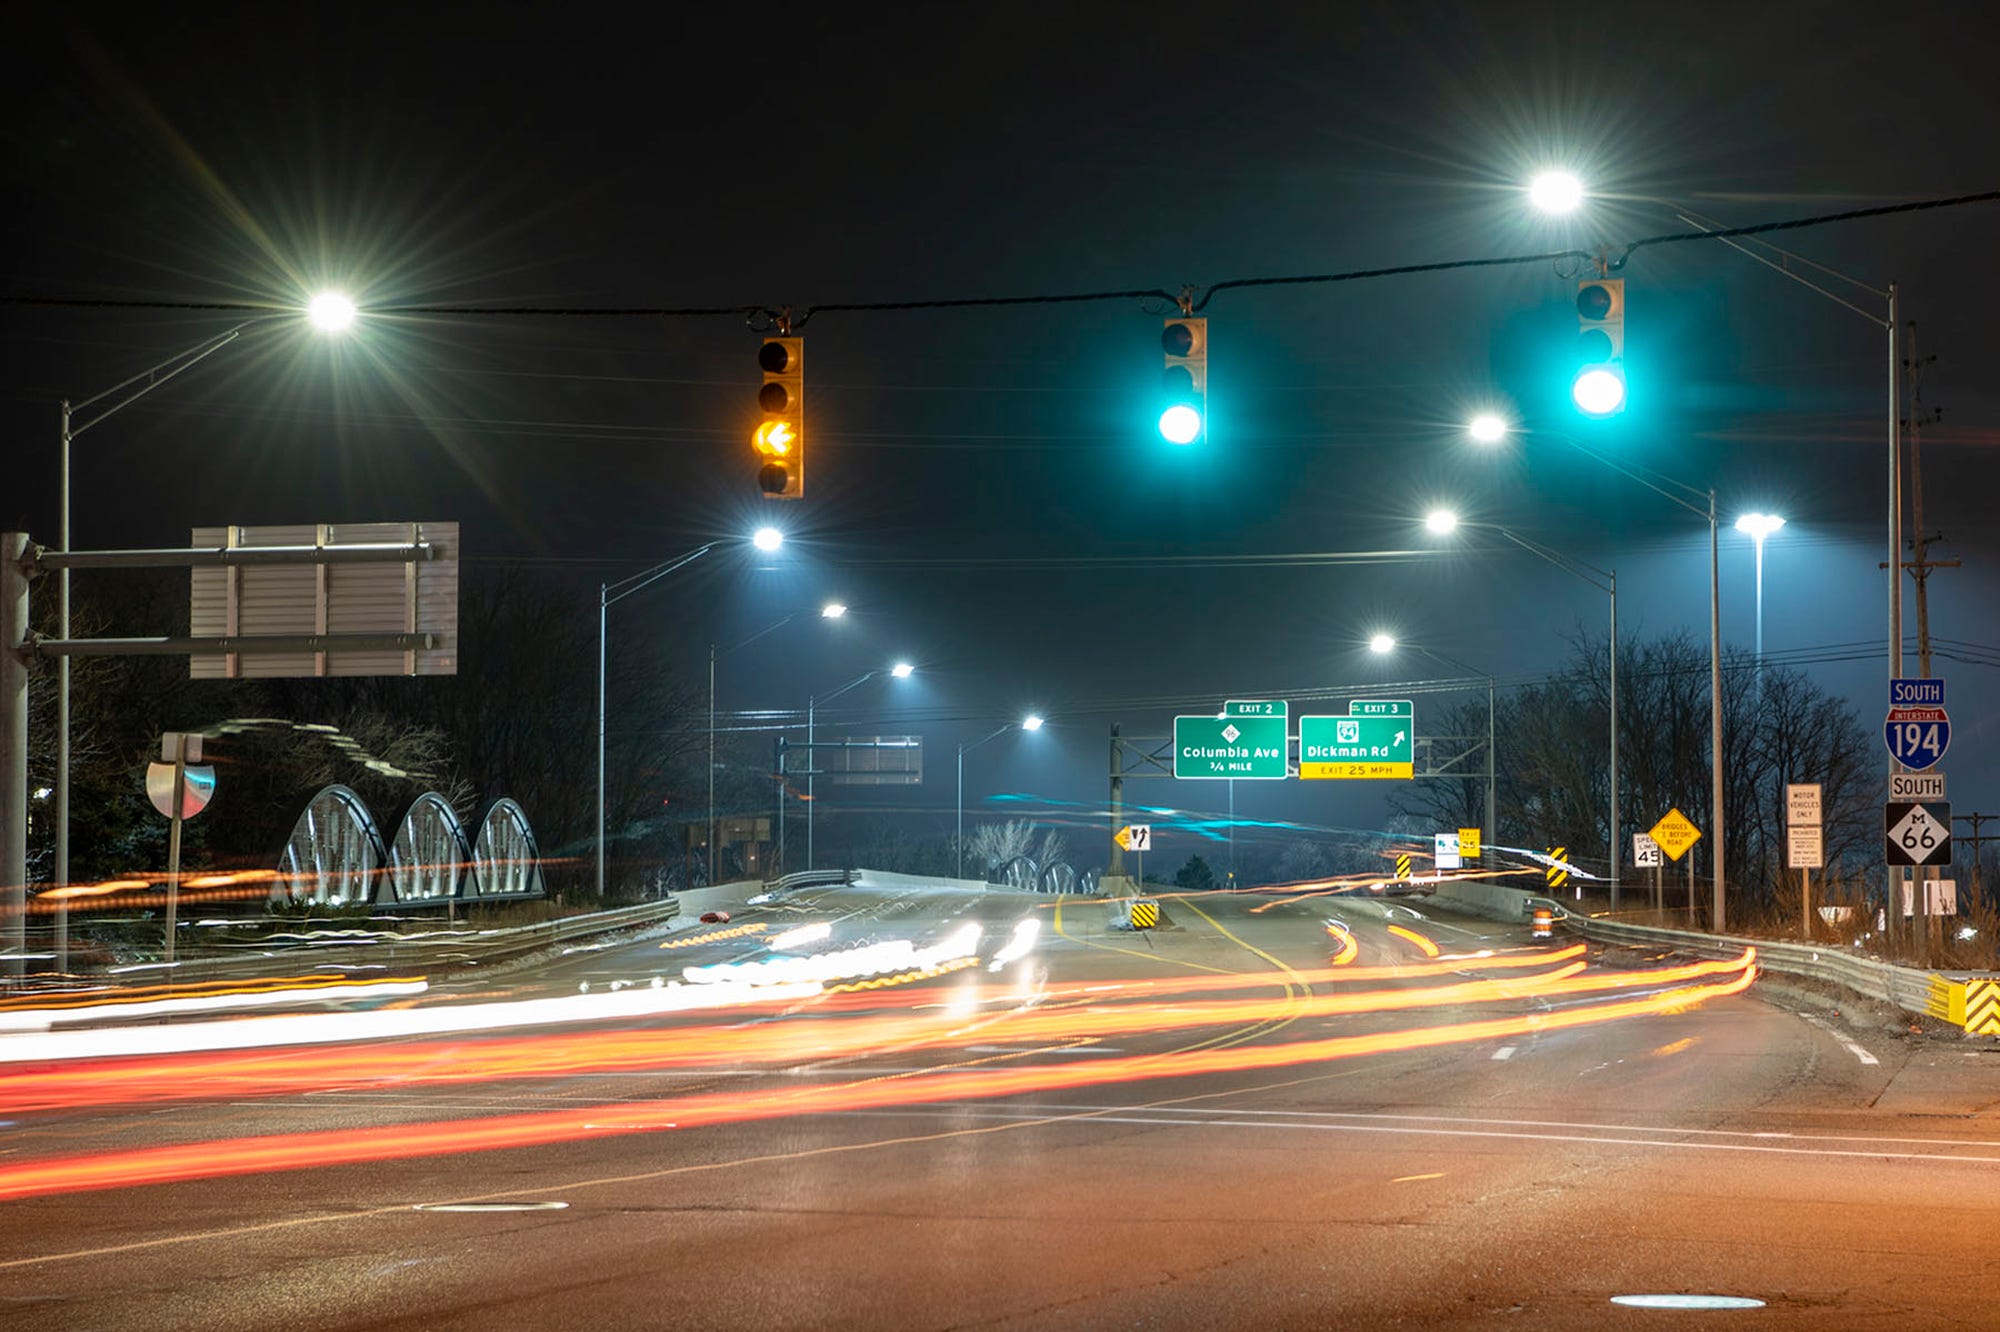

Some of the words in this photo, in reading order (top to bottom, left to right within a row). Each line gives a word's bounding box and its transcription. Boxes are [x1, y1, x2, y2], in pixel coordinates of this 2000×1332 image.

[1895, 683, 1940, 701] SOUTH
[1239, 704, 1261, 713] EXIT
[1265, 704, 1273, 714] 2
[1364, 704, 1386, 713] EXIT
[1391, 704, 1399, 714] 3
[1894, 711, 1940, 720] INTERSTATE
[1225, 729, 1236, 738] 96
[1340, 727, 1354, 738] 94
[1893, 723, 1940, 757] 194
[1183, 746, 1249, 758] Columbia
[1253, 746, 1279, 758] Ave
[1307, 746, 1367, 757] Dickman
[1371, 746, 1389, 757] Rd
[1228, 762, 1252, 771] MILE
[1321, 766, 1343, 775] EXIT
[1349, 766, 1365, 775] 25
[1893, 777, 1942, 795] SOUTH
[1790, 801, 1819, 809] VEHICLES
[1796, 810, 1812, 818] ONLY
[1911, 813, 1926, 824] M
[1902, 826, 1935, 849] 66
[1638, 851, 1659, 862] 45
